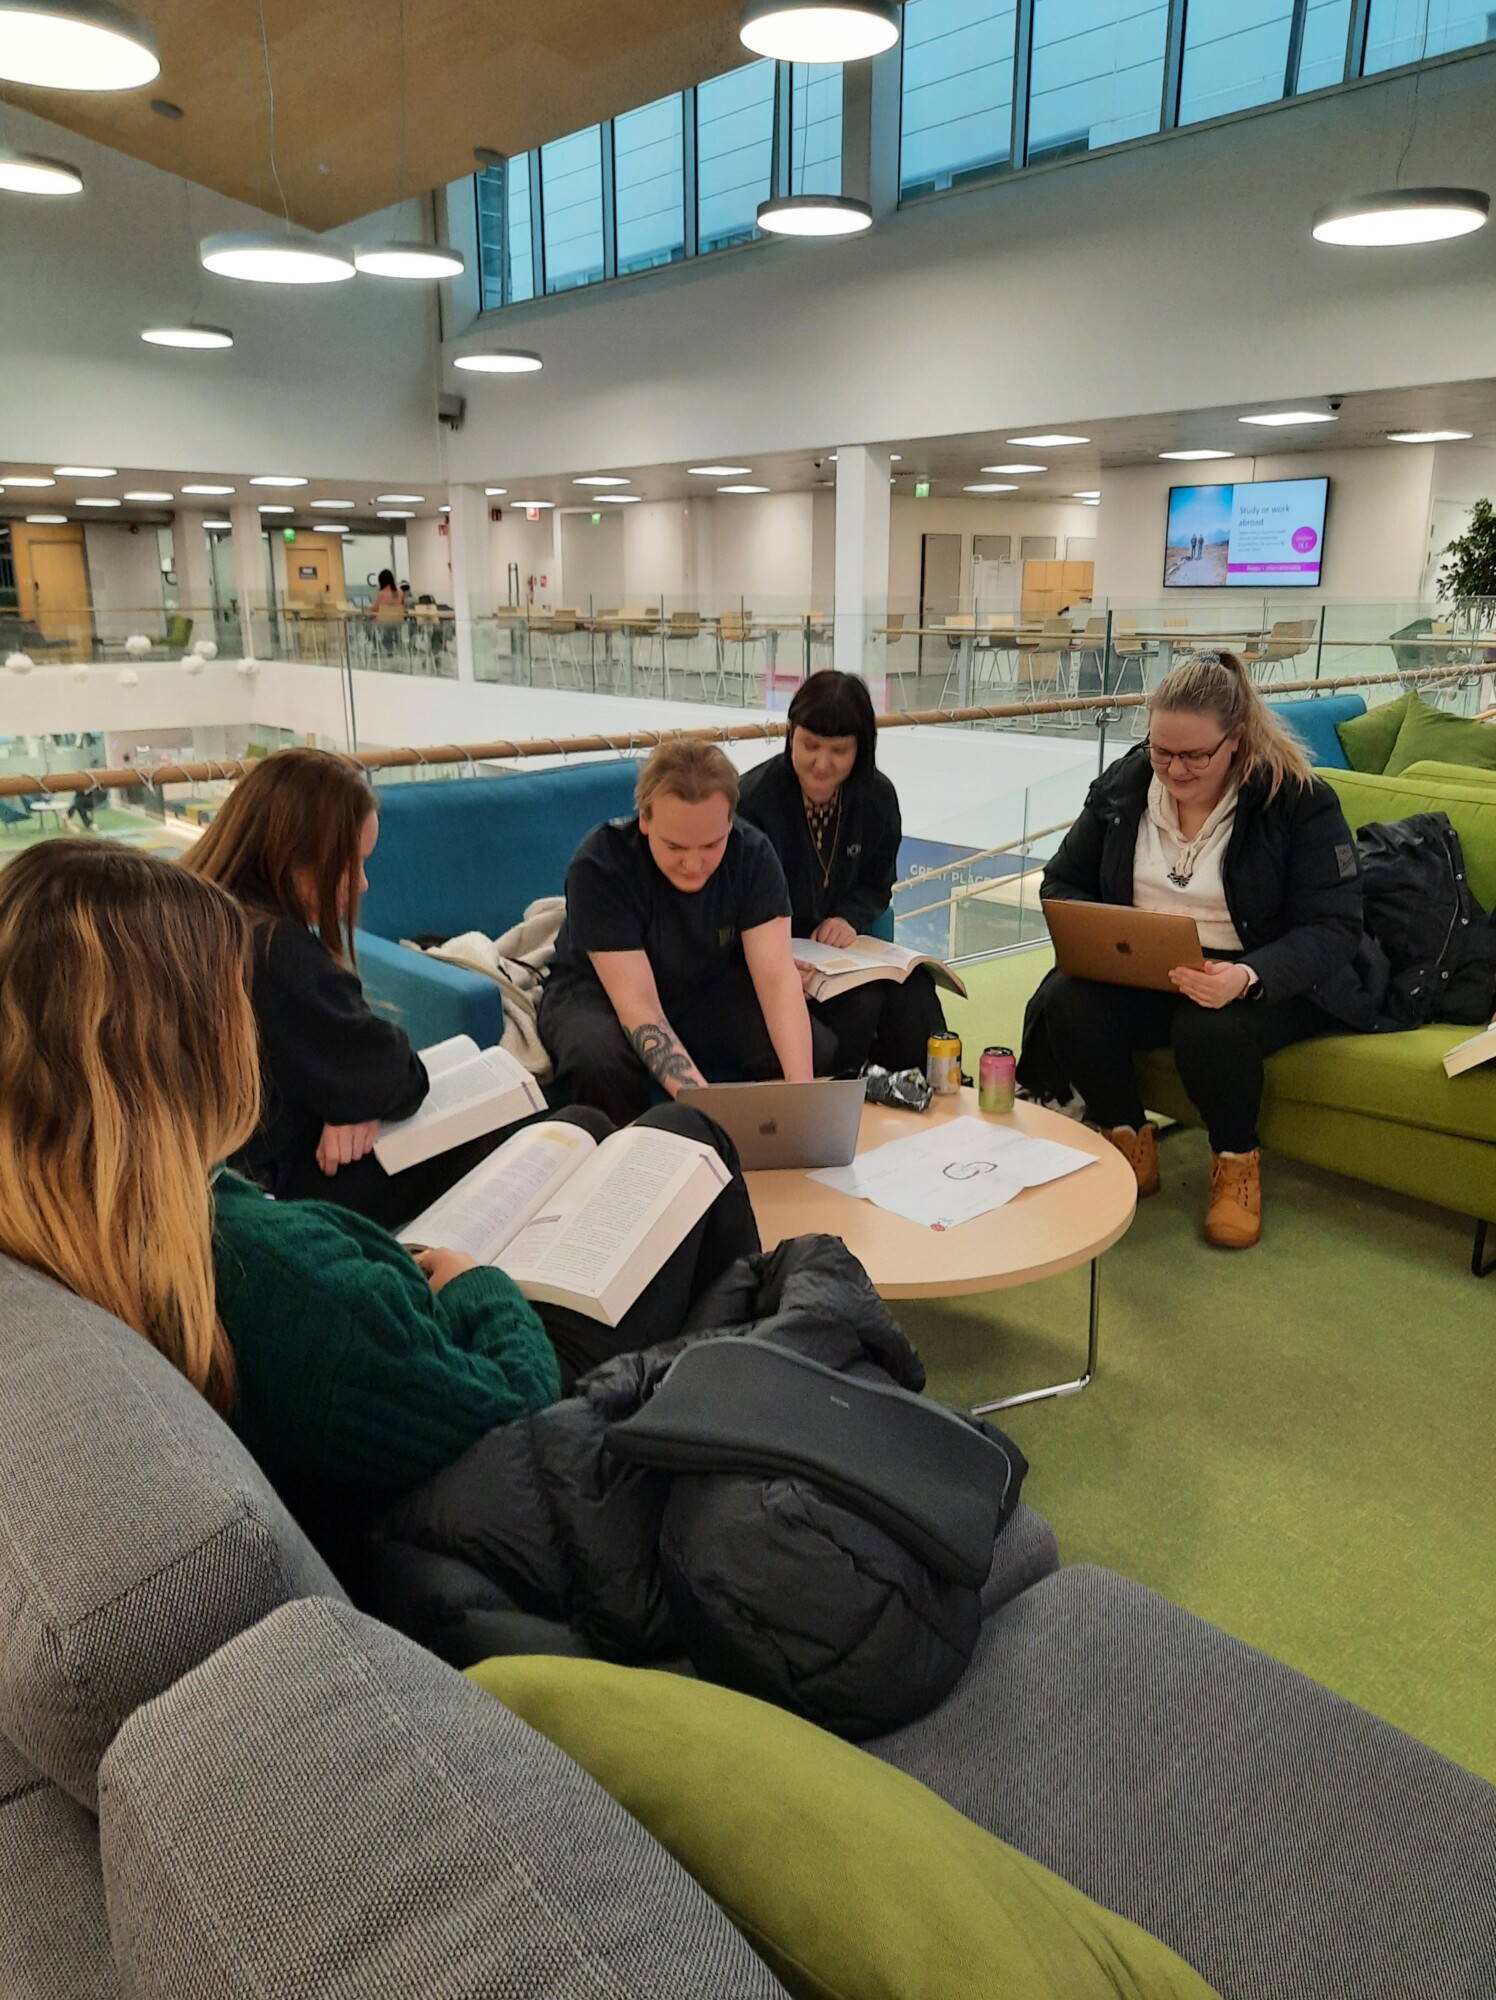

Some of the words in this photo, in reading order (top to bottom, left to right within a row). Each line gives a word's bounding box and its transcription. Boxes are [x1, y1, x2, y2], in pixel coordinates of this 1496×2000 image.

[1240, 505, 1260, 515] Study
[1271, 505, 1290, 513] work
[1238, 518, 1264, 527] abroad
